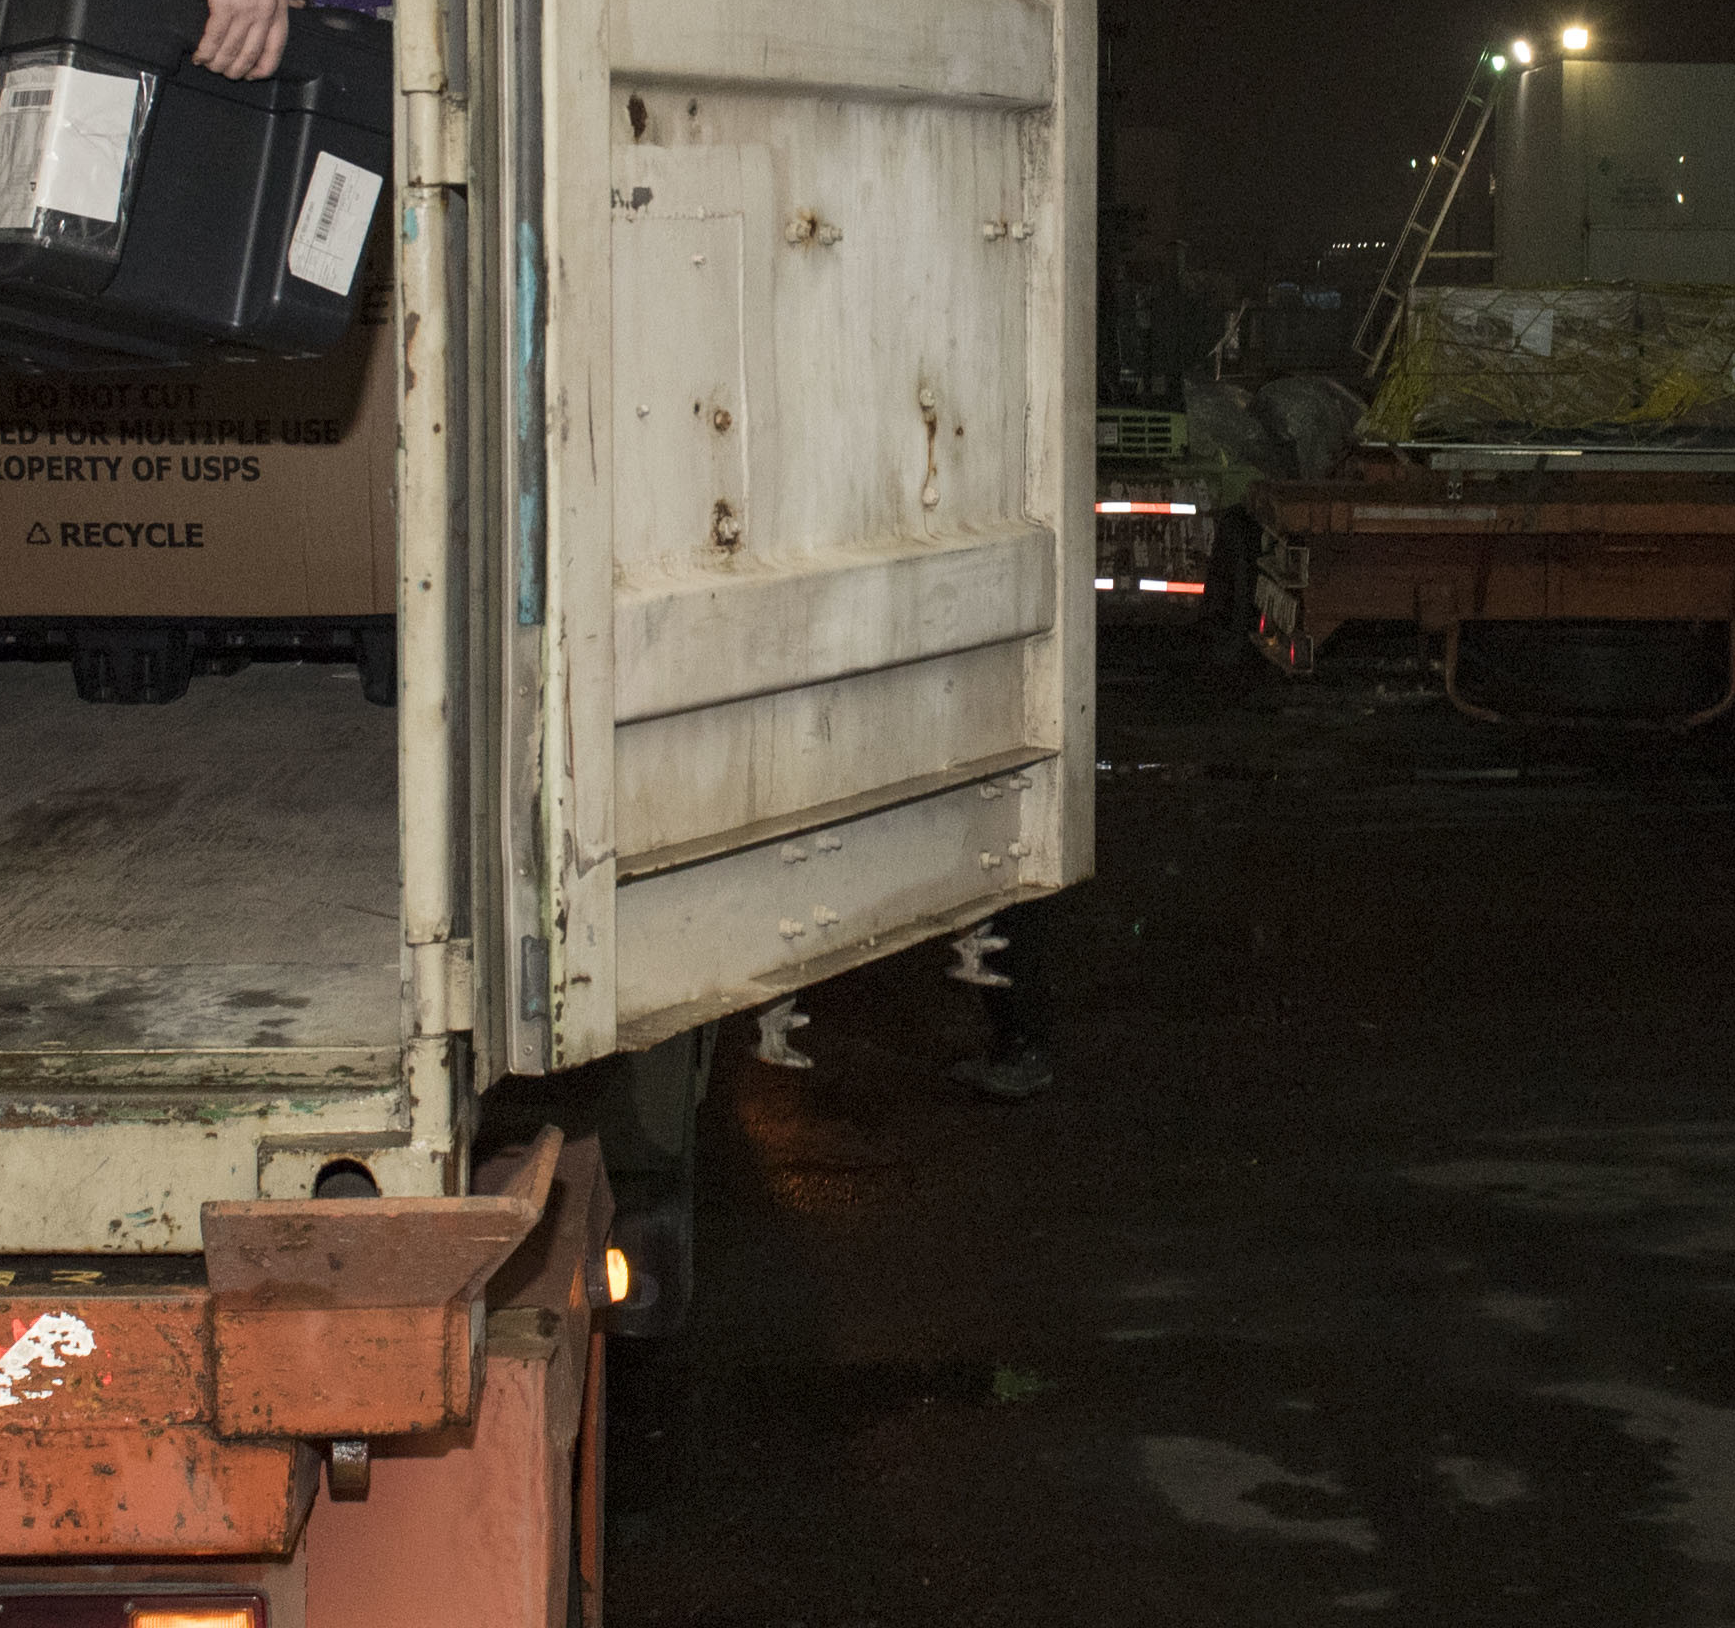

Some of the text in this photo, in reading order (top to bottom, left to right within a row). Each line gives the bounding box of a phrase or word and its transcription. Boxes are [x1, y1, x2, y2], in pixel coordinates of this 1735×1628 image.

[15, 383, 202, 411] DO NOT CUT
[48, 418, 111, 446] FOR
[119, 418, 271, 447] MULTIPLE
[280, 418, 341, 447] USE
[131, 455, 172, 482] OF
[180, 455, 262, 482] USPS
[61, 522, 204, 549] RECYCLE
